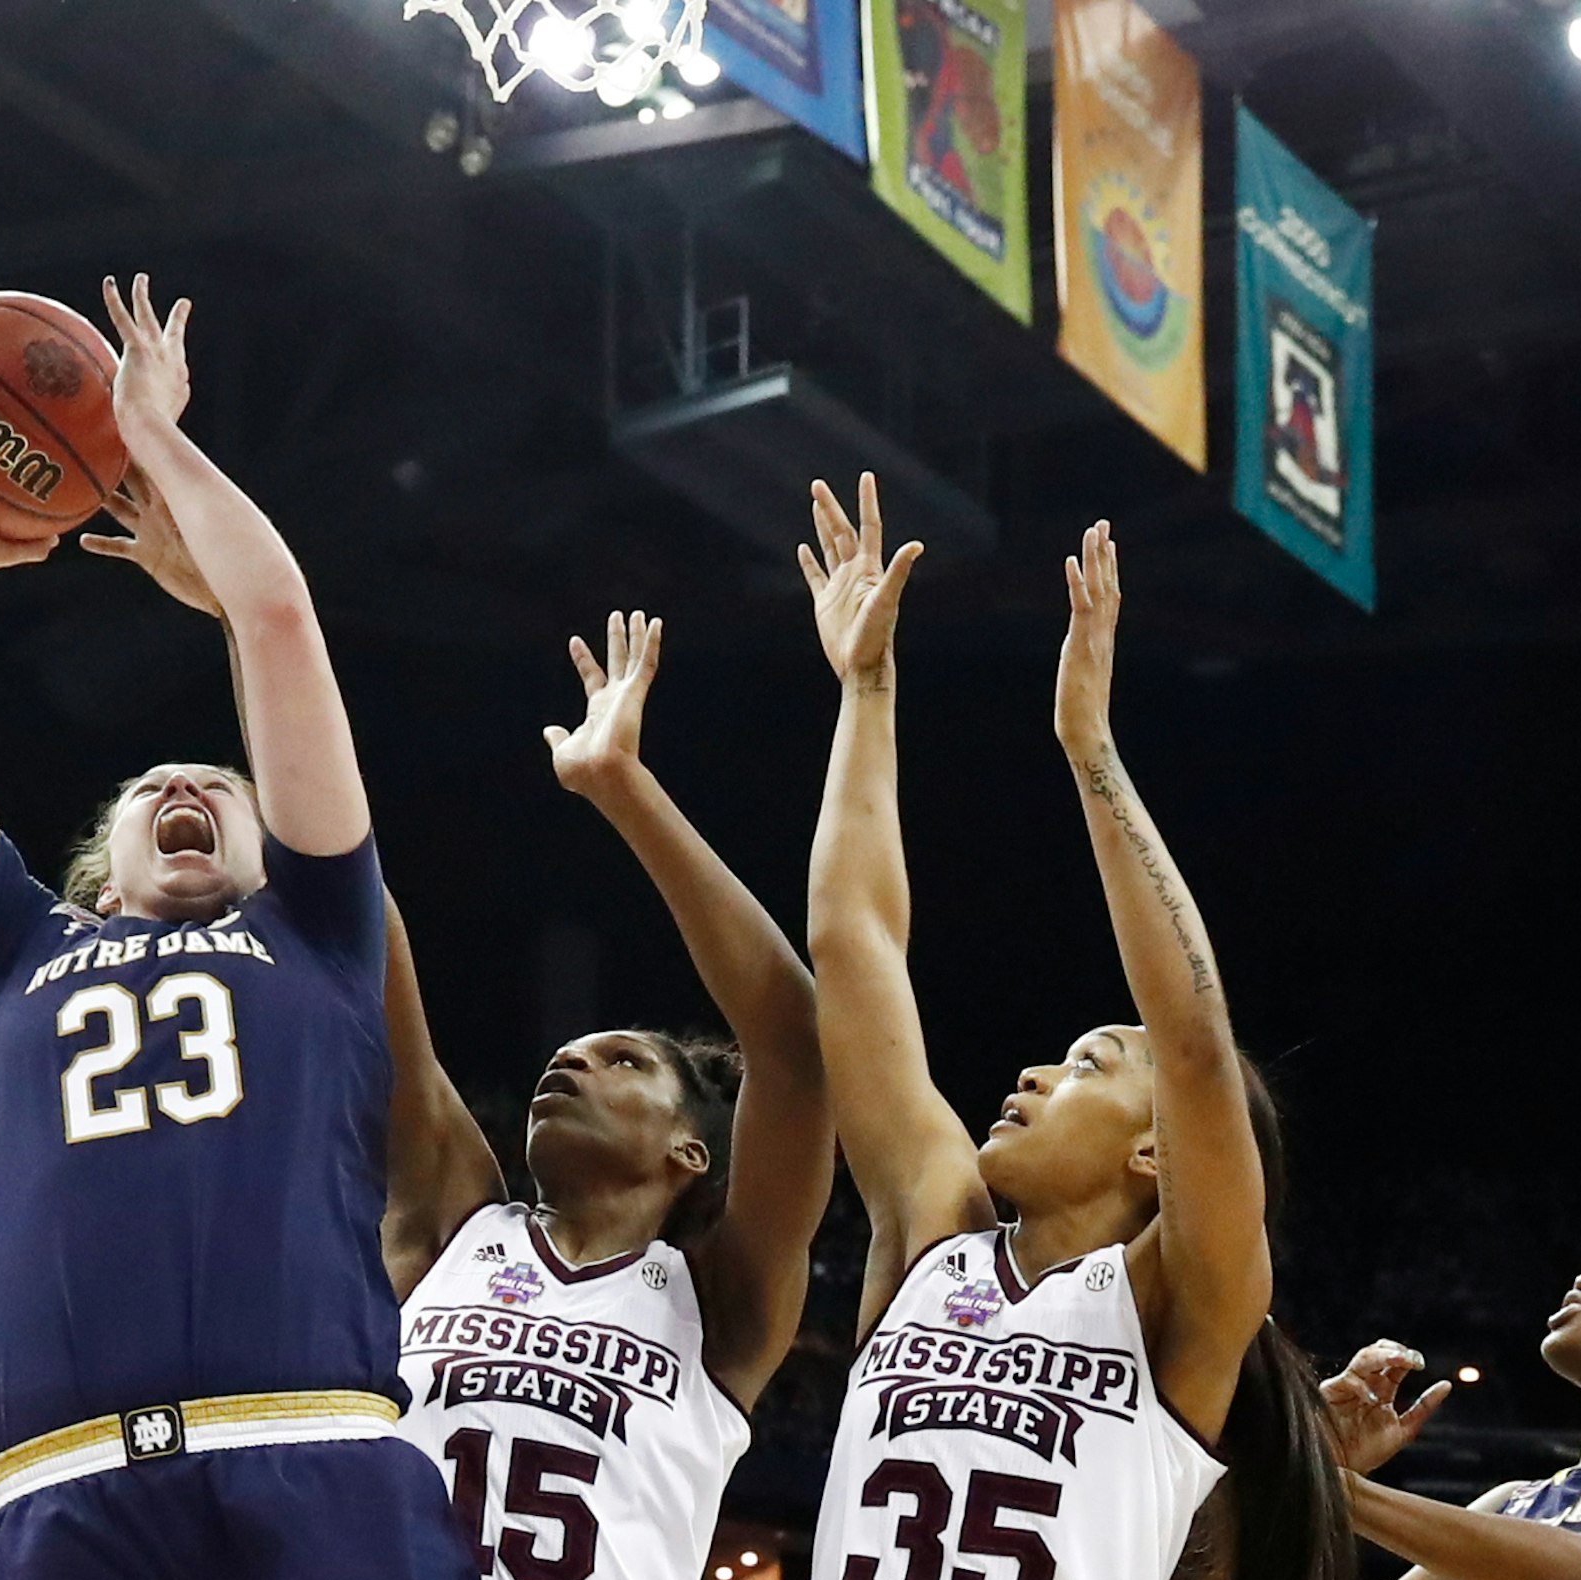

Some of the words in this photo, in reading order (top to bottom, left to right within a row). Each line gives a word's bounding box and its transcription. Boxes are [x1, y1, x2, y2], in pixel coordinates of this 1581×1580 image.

[25, 934, 151, 995] NOTRE
[156, 930, 276, 965] DAME
[57, 972, 244, 1144] 23
[405, 1313, 681, 1402] MISSISSIPPI
[861, 1331, 1139, 1411] MISSISSIPPI
[459, 1366, 596, 1423] STATE
[903, 1391, 1045, 1444] STATE
